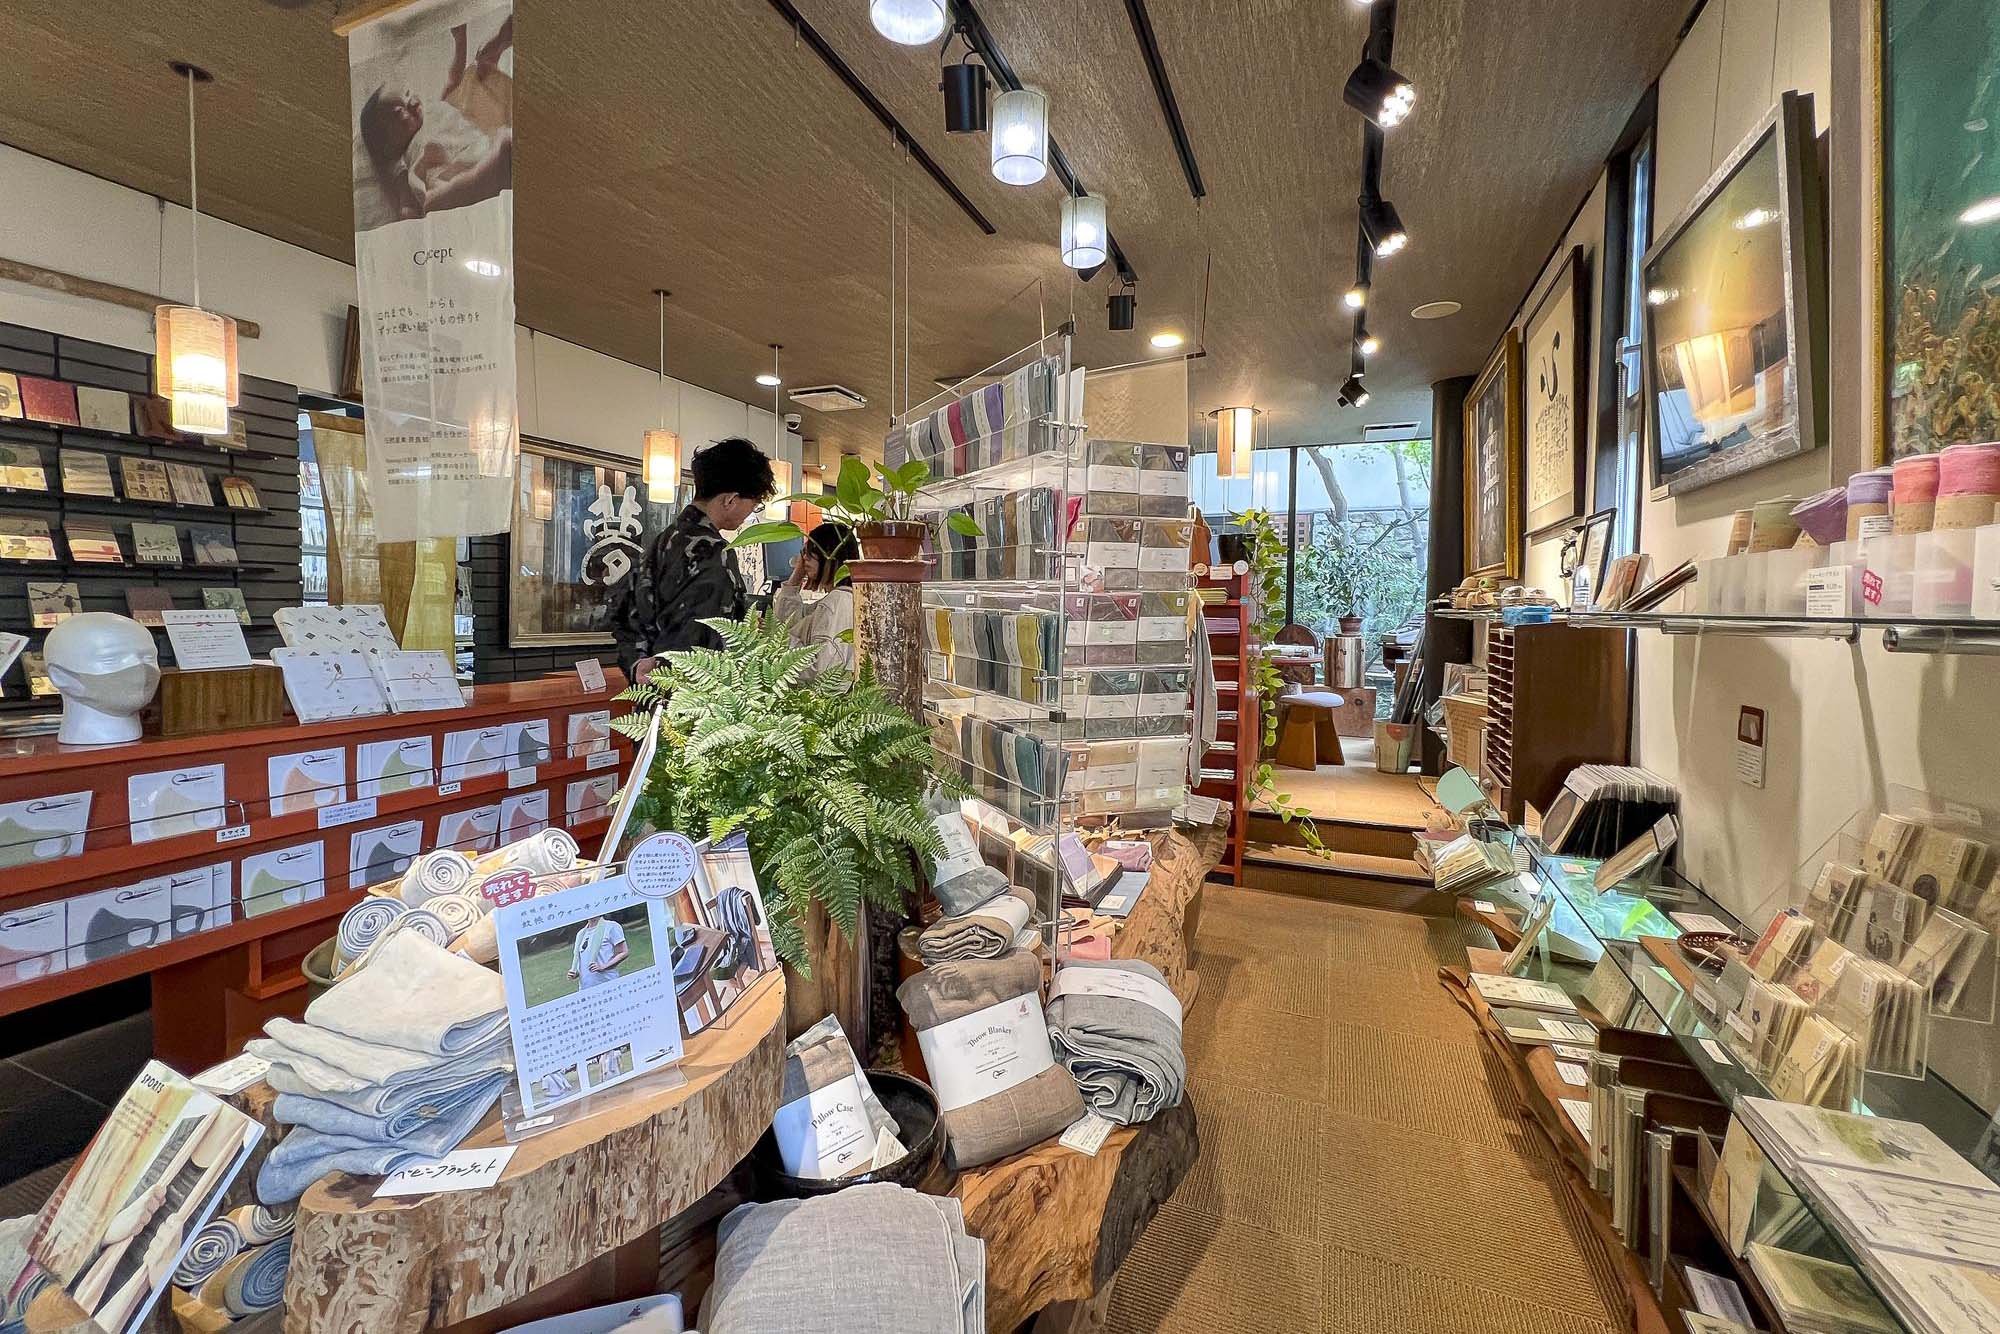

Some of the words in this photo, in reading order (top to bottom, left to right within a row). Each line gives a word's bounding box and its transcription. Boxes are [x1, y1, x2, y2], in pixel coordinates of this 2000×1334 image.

[484, 875, 527, 895] 売れて
[498, 885, 534, 906] ます!
[967, 1031, 987, 1048] Throw
[987, 1026, 1012, 1036] Blanket
[140, 1073, 165, 1094] SPORTS
[811, 1107, 835, 1129] Pillow
[836, 1103, 855, 1113] Case
